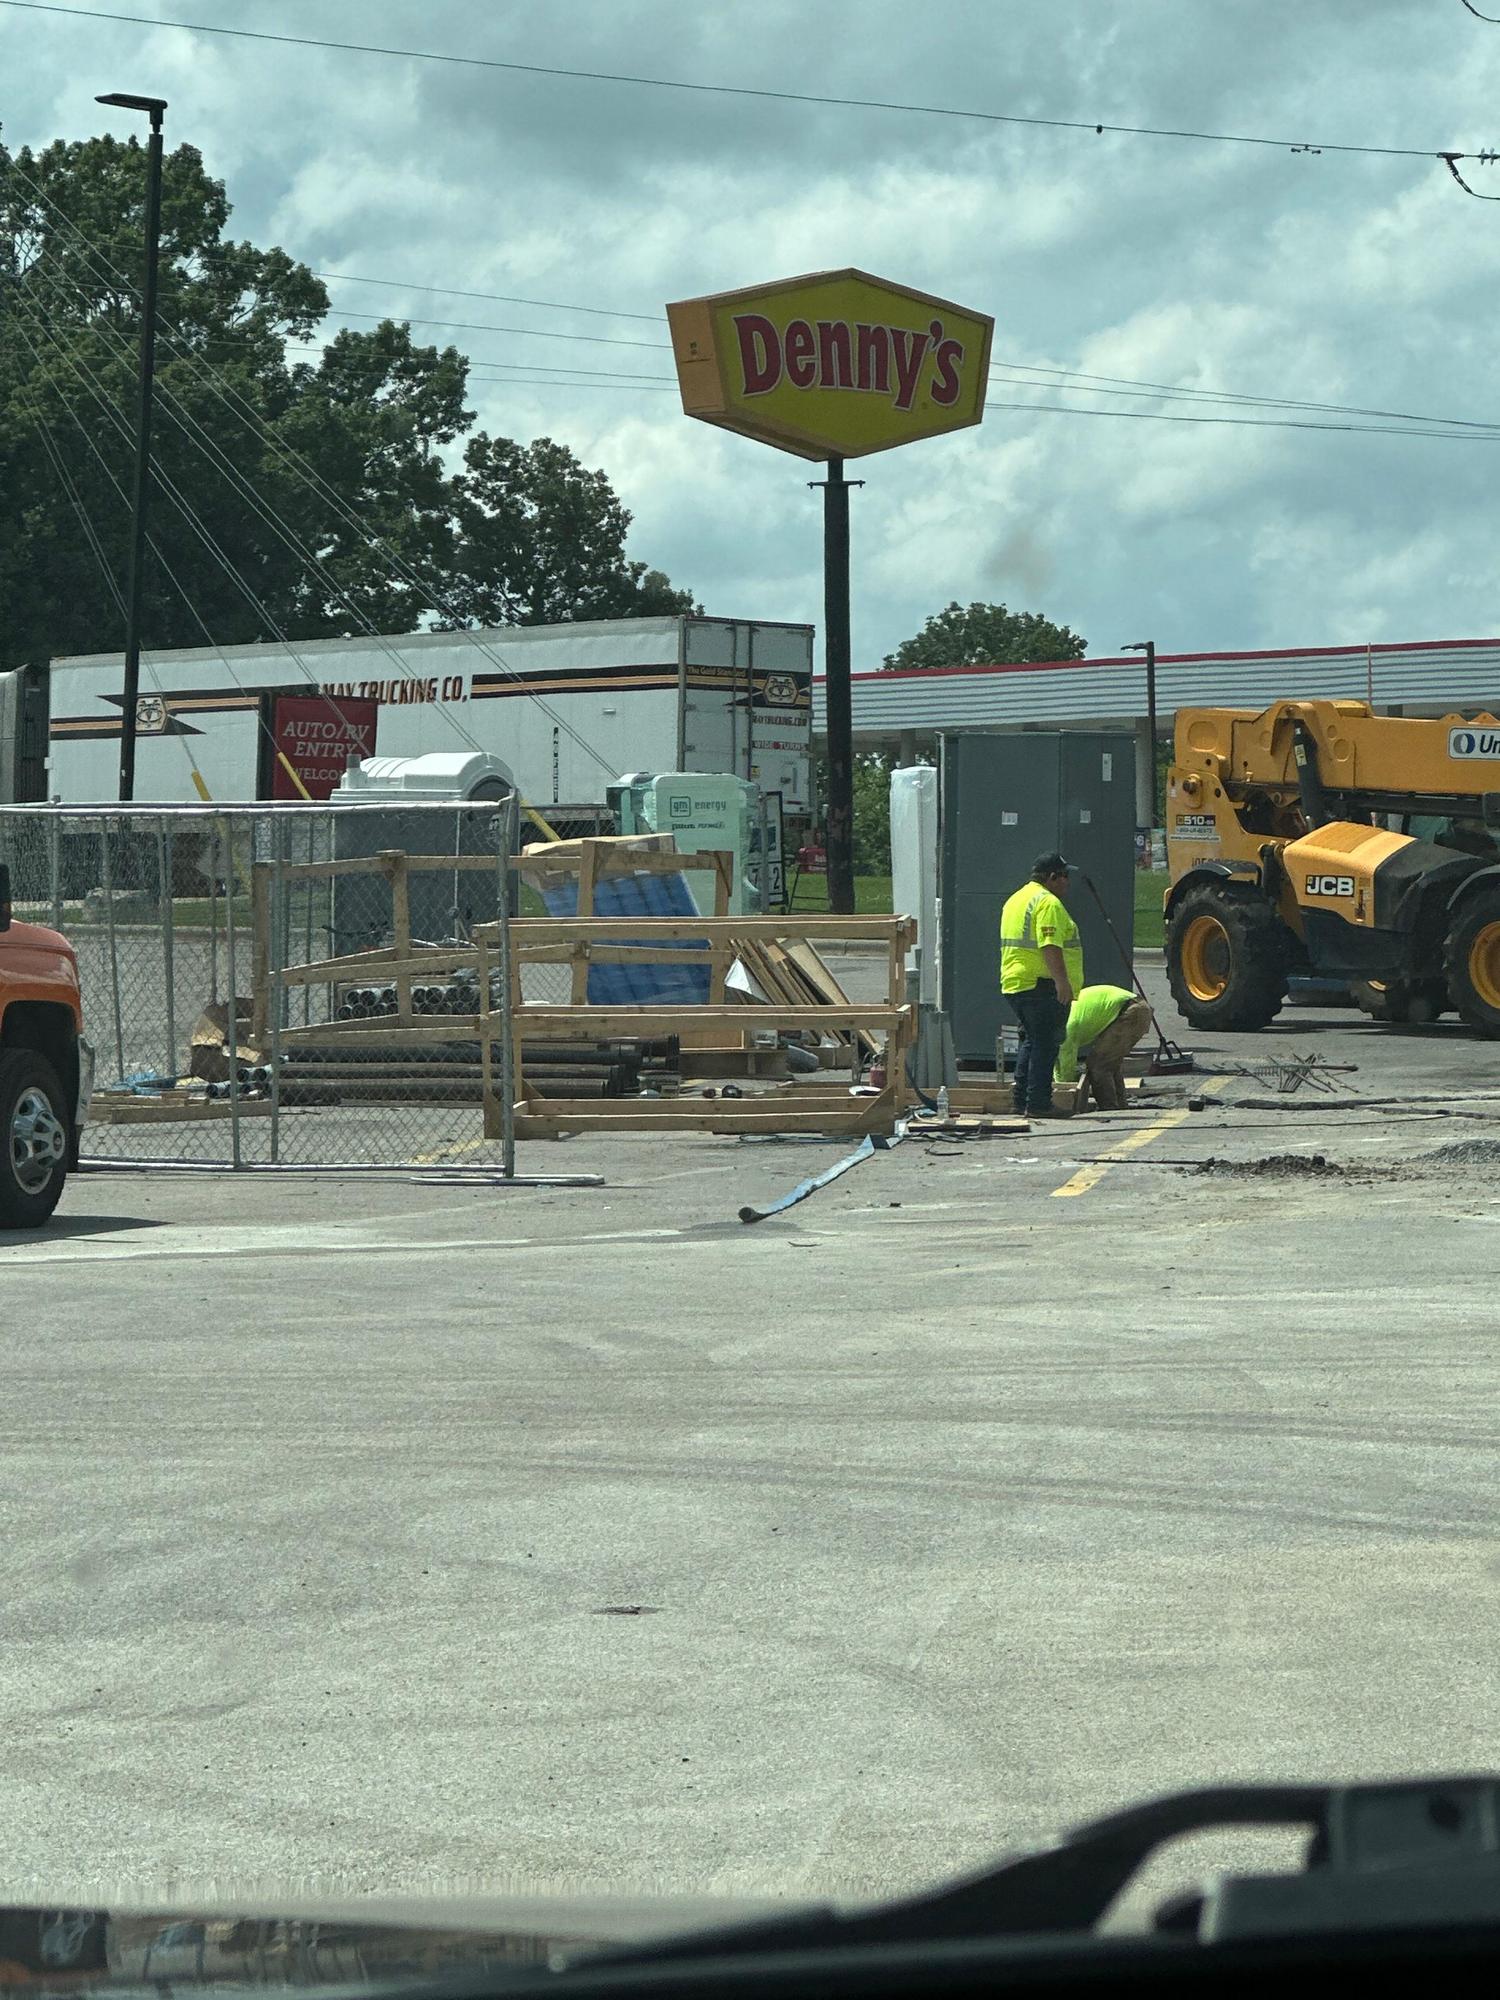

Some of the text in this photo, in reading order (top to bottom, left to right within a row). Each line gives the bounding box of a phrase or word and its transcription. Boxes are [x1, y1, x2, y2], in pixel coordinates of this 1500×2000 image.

[732, 312, 967, 412] Denny's
[358, 677, 438, 704] TRUCKING
[282, 721, 370, 740] AUTO/RV
[293, 741, 358, 759] ENTRY
[673, 800, 727, 812] gm energy
[1306, 876, 1354, 896] JCB
